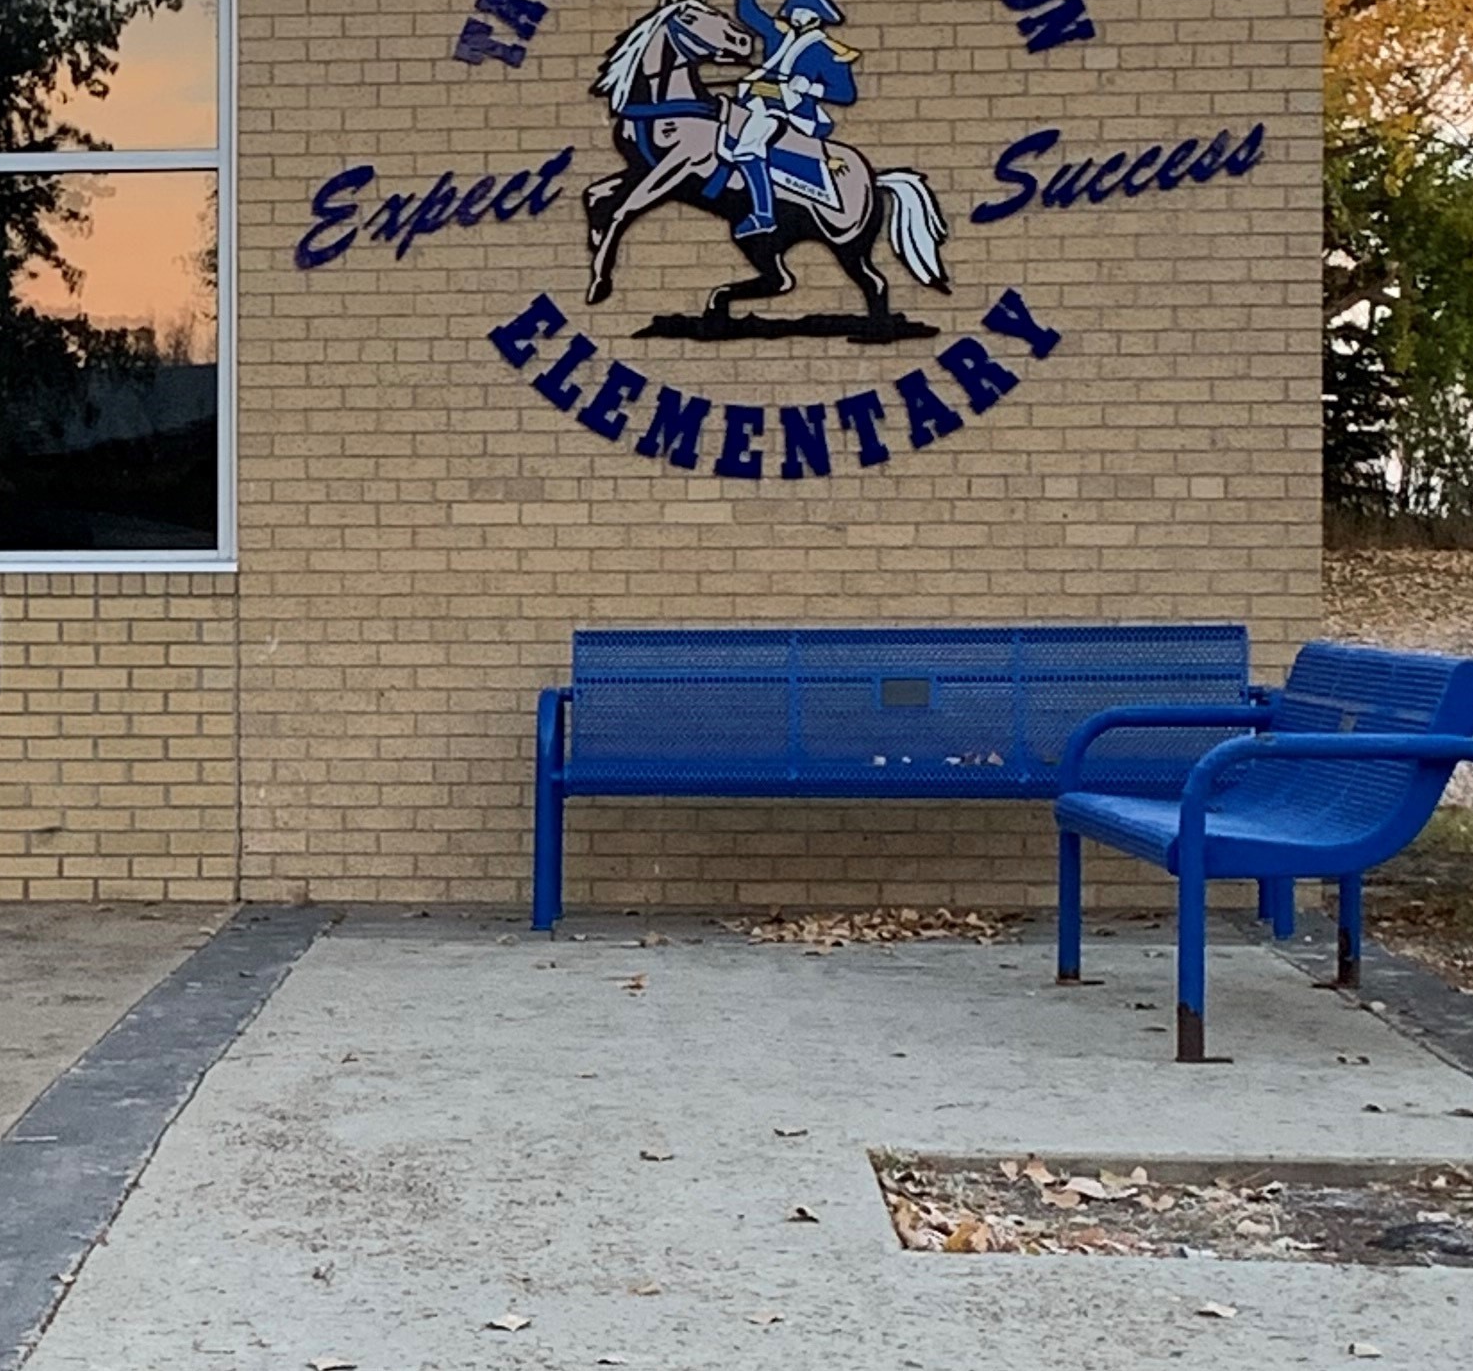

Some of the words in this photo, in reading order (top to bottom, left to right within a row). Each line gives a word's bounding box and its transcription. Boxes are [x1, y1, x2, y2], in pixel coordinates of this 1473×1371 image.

[295, 146, 575, 270] Expect
[970, 123, 1264, 225] Success
[487, 288, 1062, 480] ELEMENTARY
